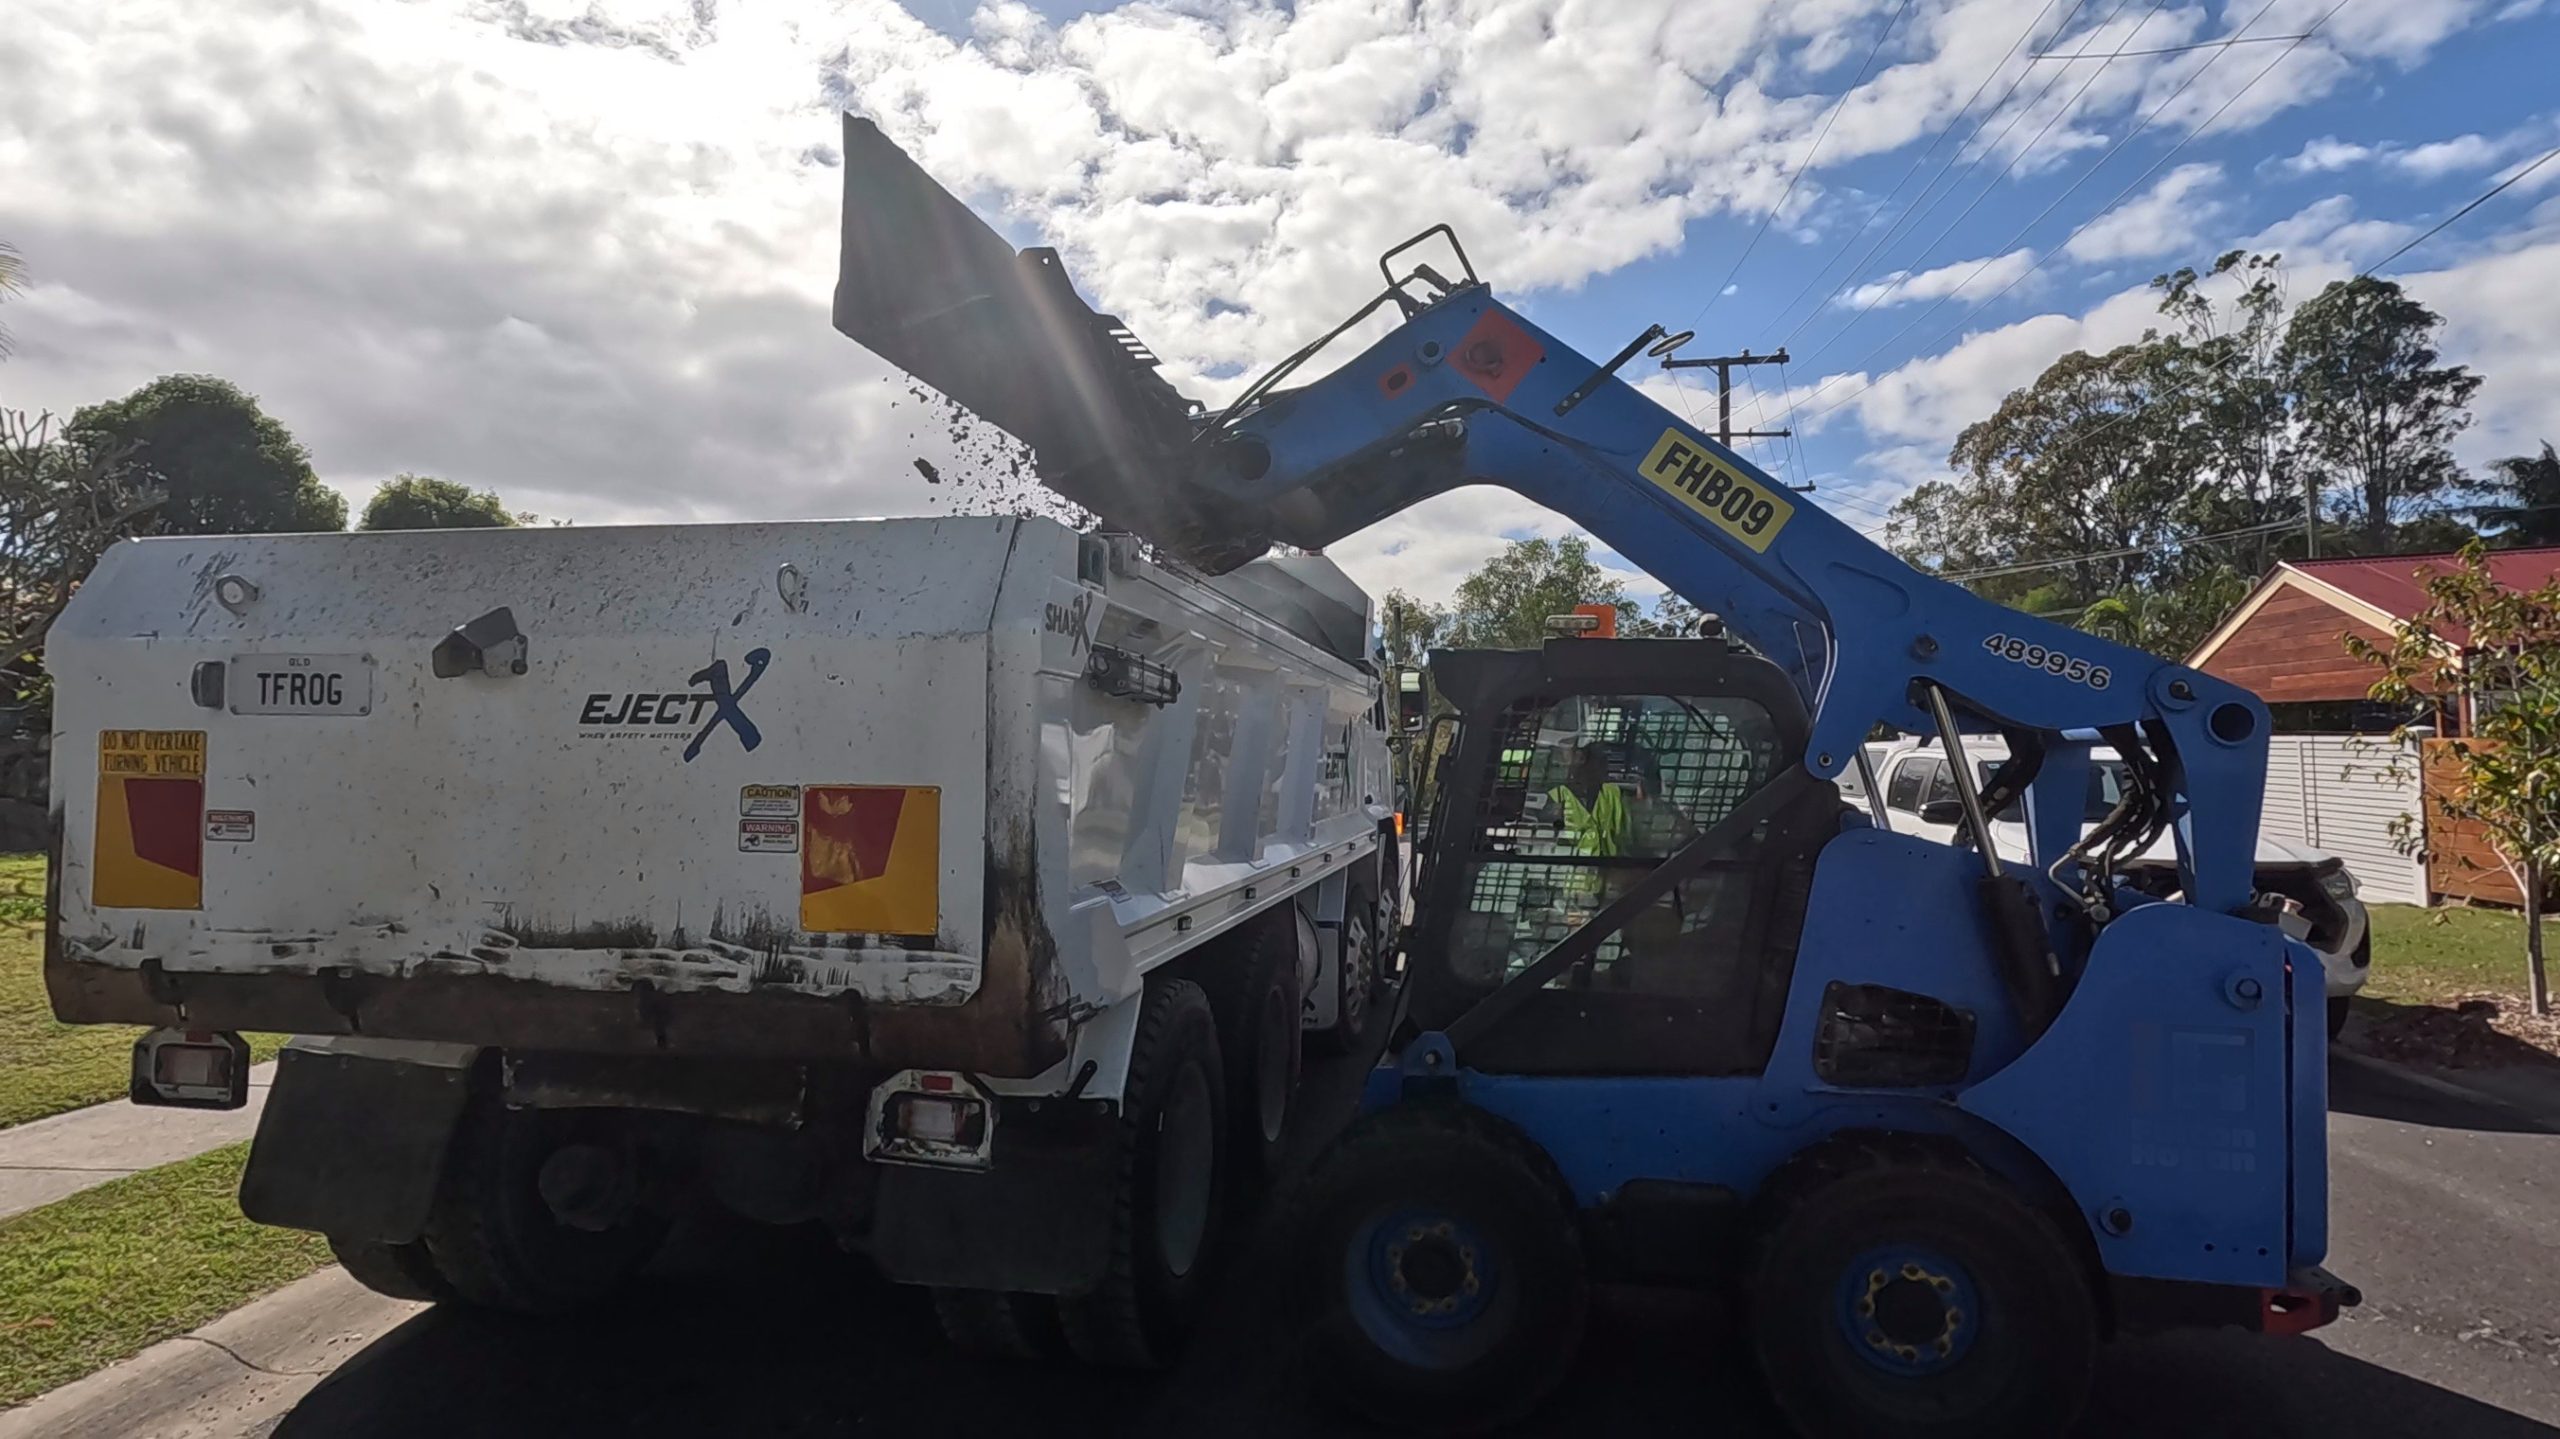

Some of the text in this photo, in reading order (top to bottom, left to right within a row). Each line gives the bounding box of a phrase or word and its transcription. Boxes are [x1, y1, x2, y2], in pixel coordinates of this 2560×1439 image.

[1654, 441, 1774, 535] FHB09
[1982, 633, 2111, 690] 489956
[257, 673, 342, 705] TFROG
[103, 732, 117, 750] DO
[578, 732, 605, 740] WHEN
[609, 732, 646, 740] SAFETY
[746, 788, 793, 798] CAUTION
[745, 824, 793, 833] WARNING
